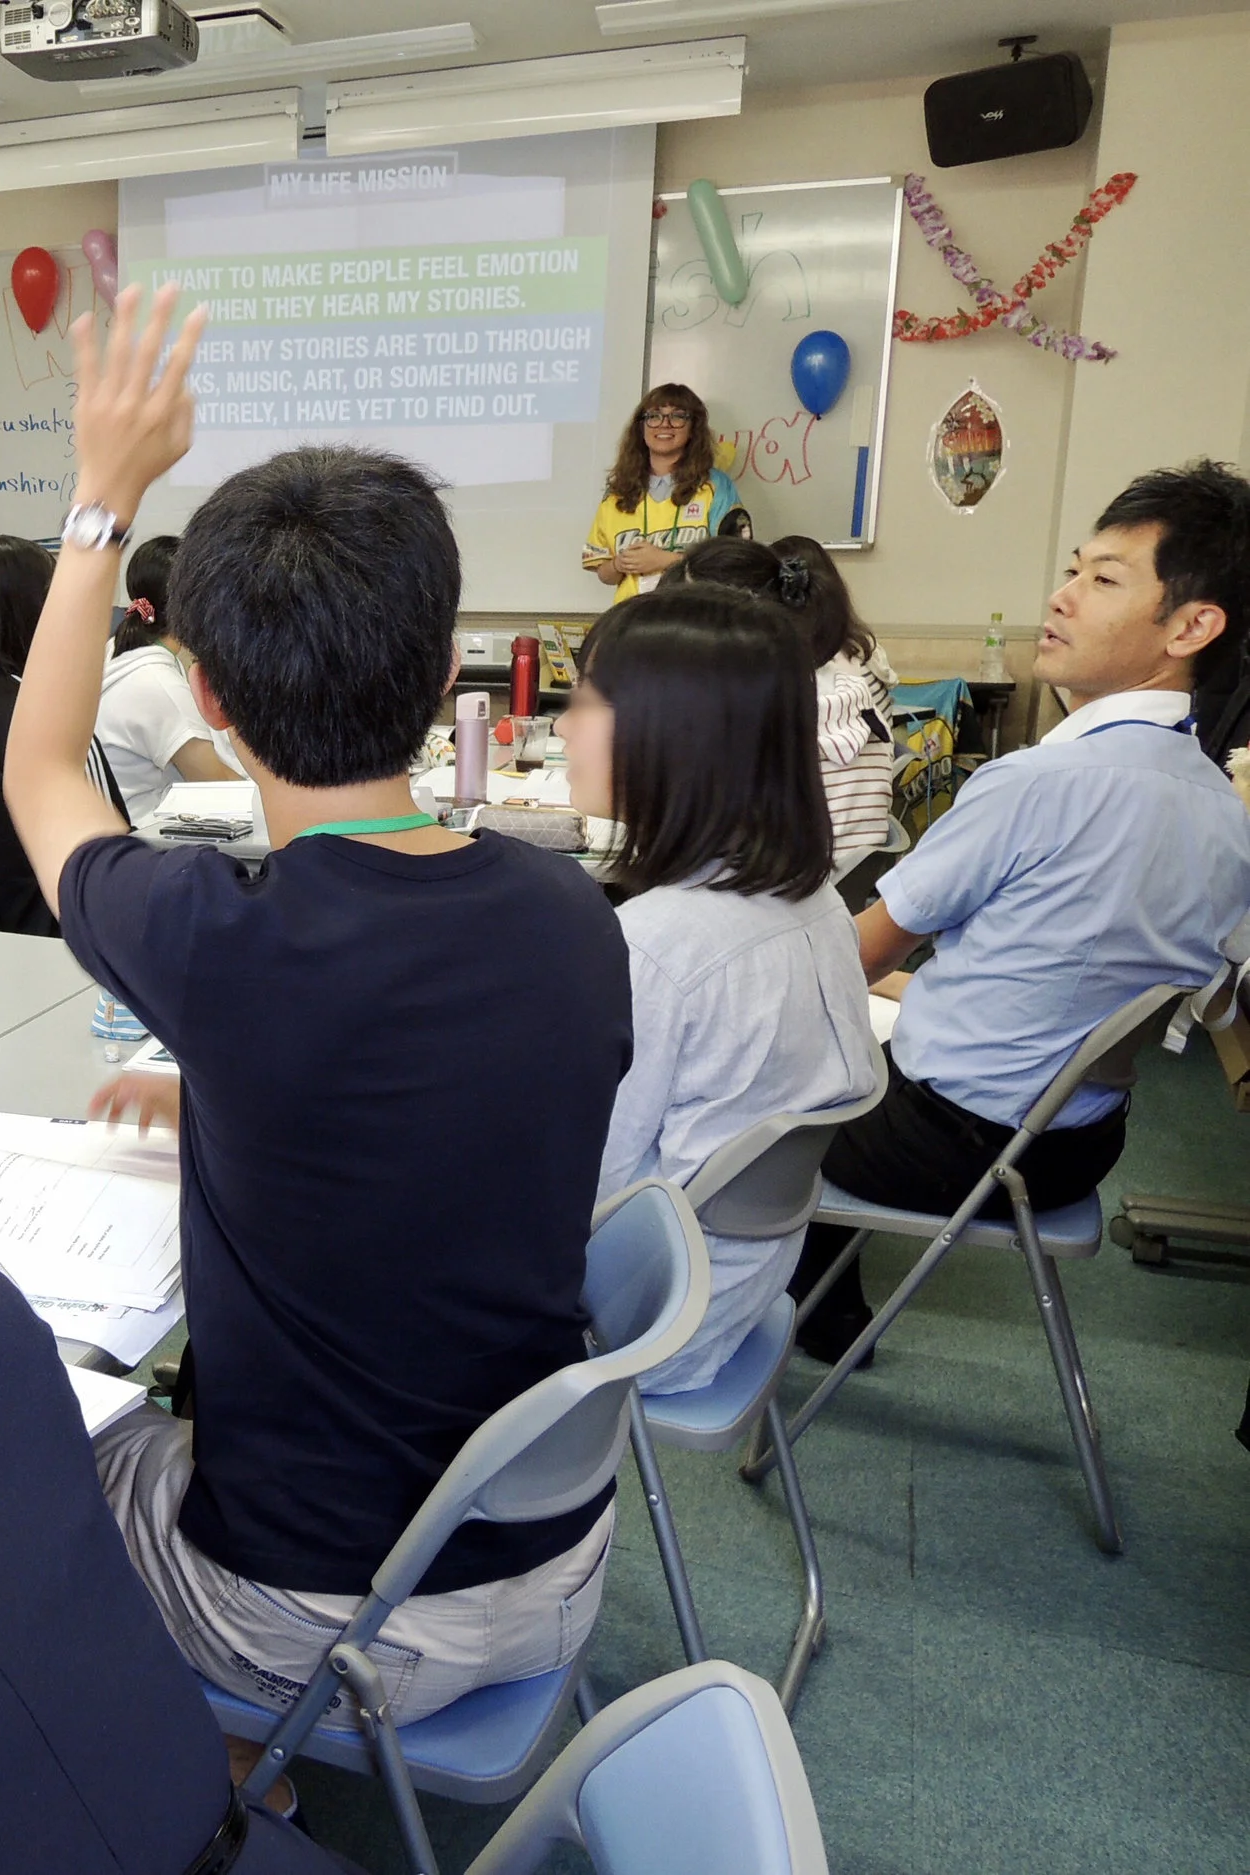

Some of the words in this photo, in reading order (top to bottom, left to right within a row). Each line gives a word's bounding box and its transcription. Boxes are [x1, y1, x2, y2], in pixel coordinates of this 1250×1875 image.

[270, 172, 302, 197] MY
[309, 170, 352, 195] LIFE
[357, 165, 447, 192] MISSION
[159, 267, 224, 292] WANT
[229, 266, 255, 289] TO
[262, 263, 323, 287] MAKE
[329, 258, 411, 284] PEOPLE
[418, 255, 469, 281] FEEL
[476, 249, 579, 277] EMOTION
[262, 295, 316, 319] THEY
[323, 292, 380, 317] HEAR
[386, 290, 421, 314] MY
[427, 285, 526, 313] STORIES.
[242, 339, 274, 362] MY
[280, 335, 369, 361] STORIES
[374, 333, 417, 357] ARE
[423, 331, 478, 355] TOLD
[485, 326, 592, 353] THROUGH
[227, 369, 298, 395] MUSIC,
[303, 367, 348, 394] ART,
[354, 366, 383, 390] OR
[389, 361, 518, 389] SOMETHING
[525, 359, 580, 384] ELSE
[193, 401, 278, 426] NTIRELY,
[284, 400, 290, 423] I
[296, 399, 351, 423] HAVE
[356, 397, 395, 421] YET
[401, 396, 429, 420] TO
[435, 395, 486, 419] FIND
[492, 392, 539, 417] OUT.
